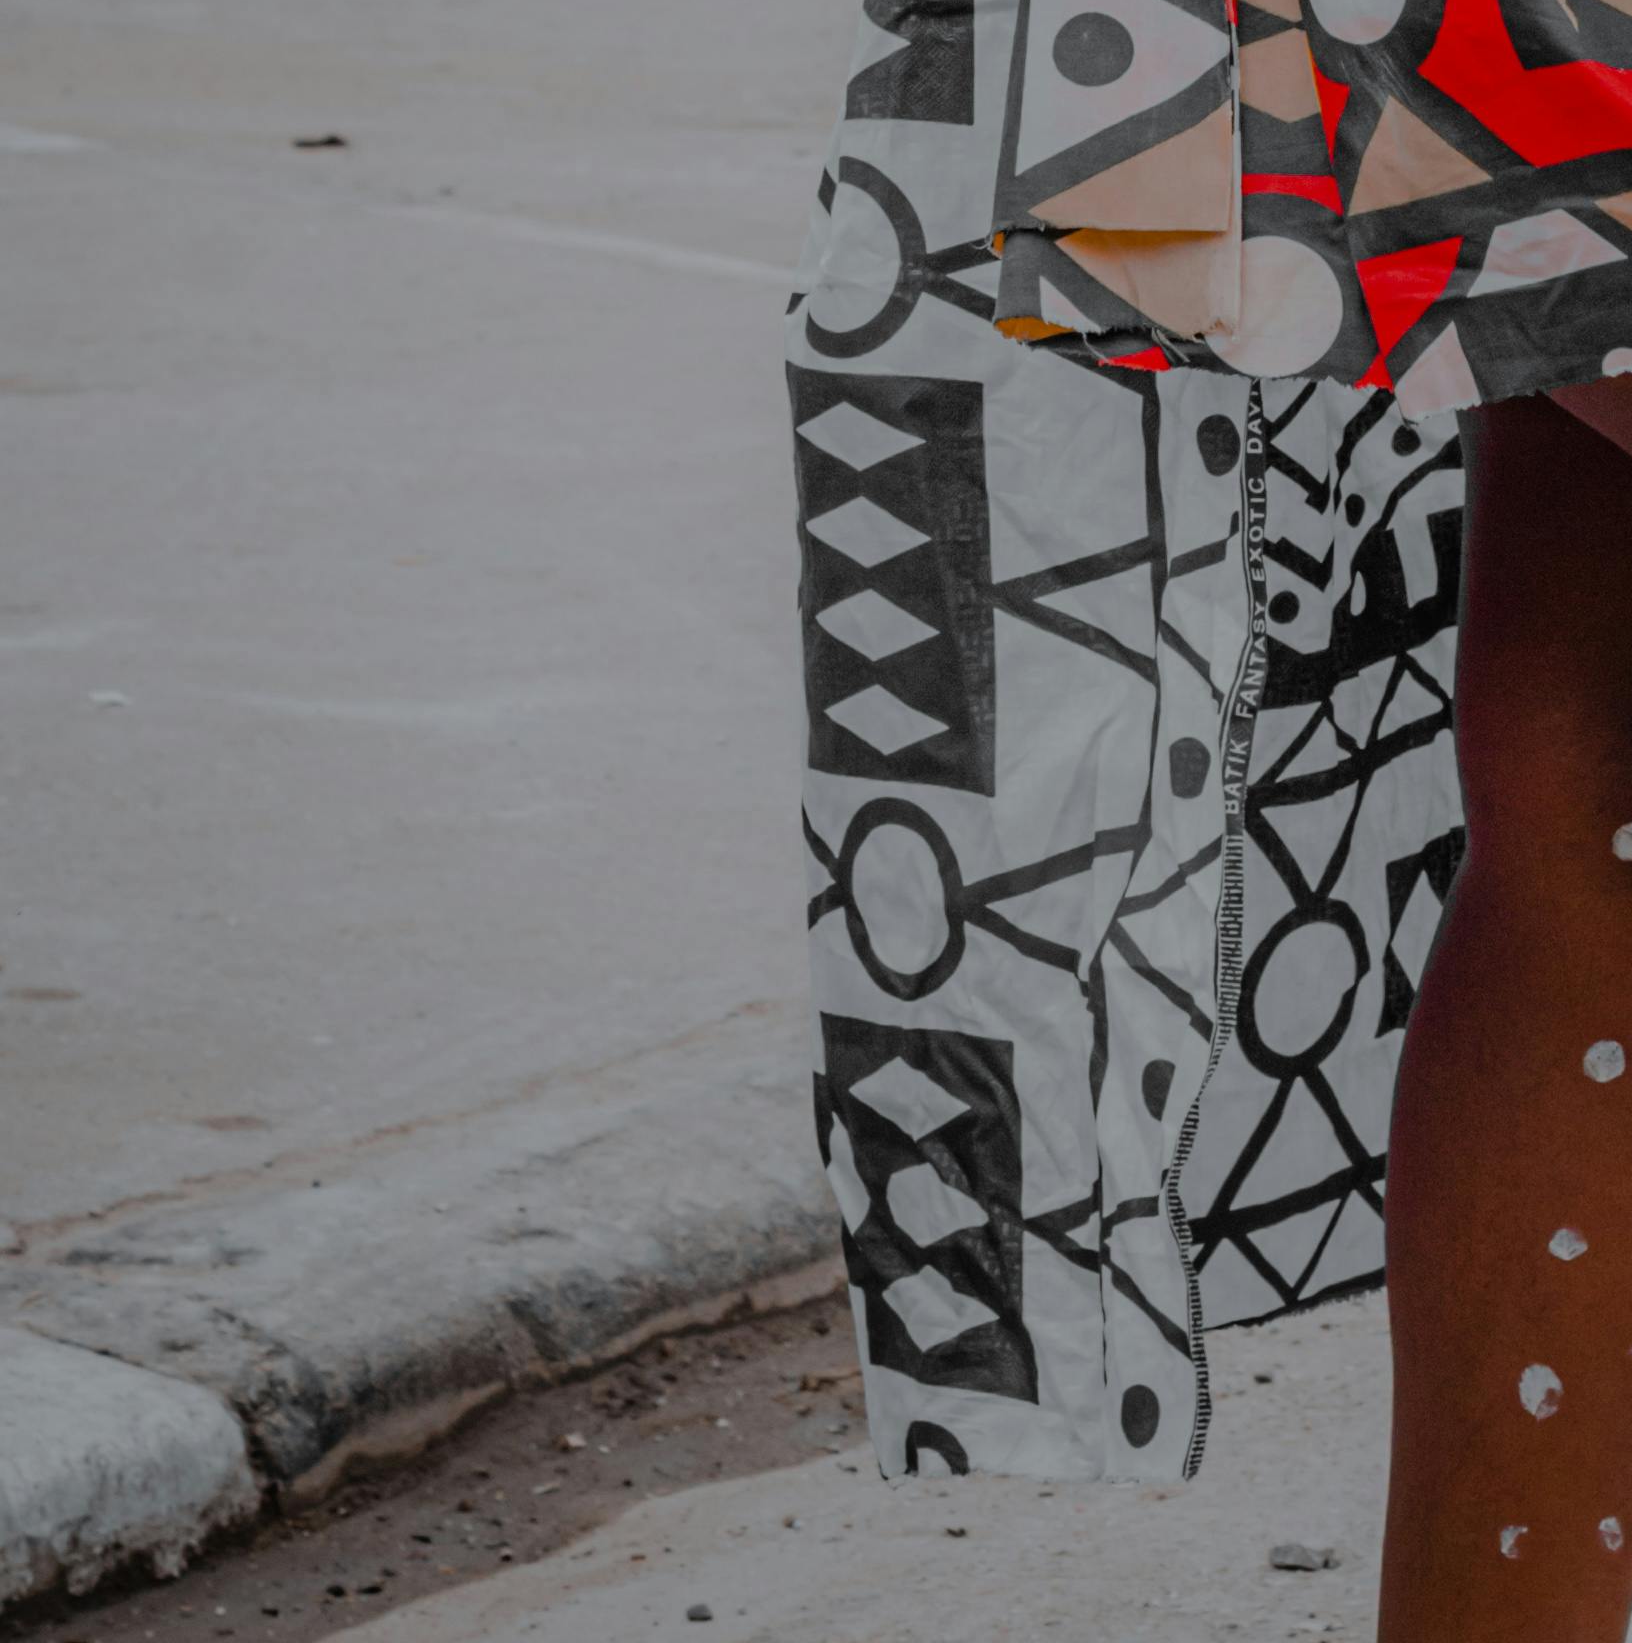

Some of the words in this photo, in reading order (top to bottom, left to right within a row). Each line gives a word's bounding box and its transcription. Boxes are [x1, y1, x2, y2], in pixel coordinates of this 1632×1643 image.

[1247, 477, 1266, 582] EXOTIC
[1235, 601, 1266, 719] FANTASY
[1223, 738, 1249, 815] BATIK
